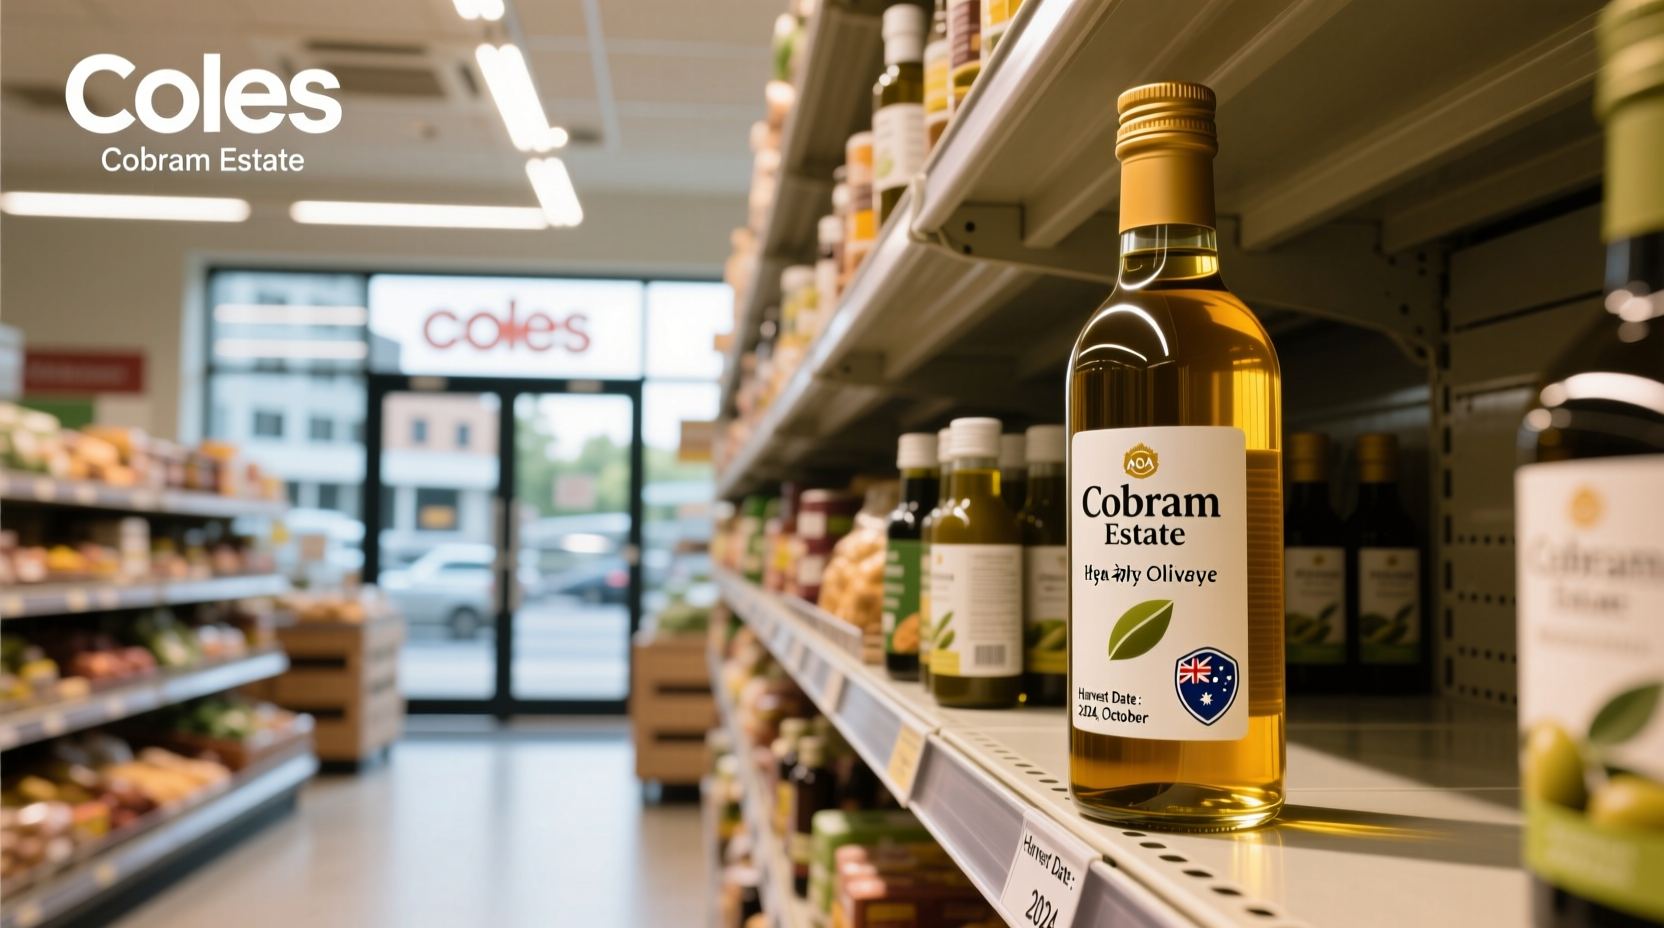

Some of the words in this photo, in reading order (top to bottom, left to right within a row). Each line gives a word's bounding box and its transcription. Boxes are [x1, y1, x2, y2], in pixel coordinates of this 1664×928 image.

[423, 300, 591, 352] coles
[1082, 483, 1221, 518] Cobram
[1104, 523, 1186, 546] Estate
[1111, 690, 1142, 706] Date:
[1101, 706, 1149, 724] October
